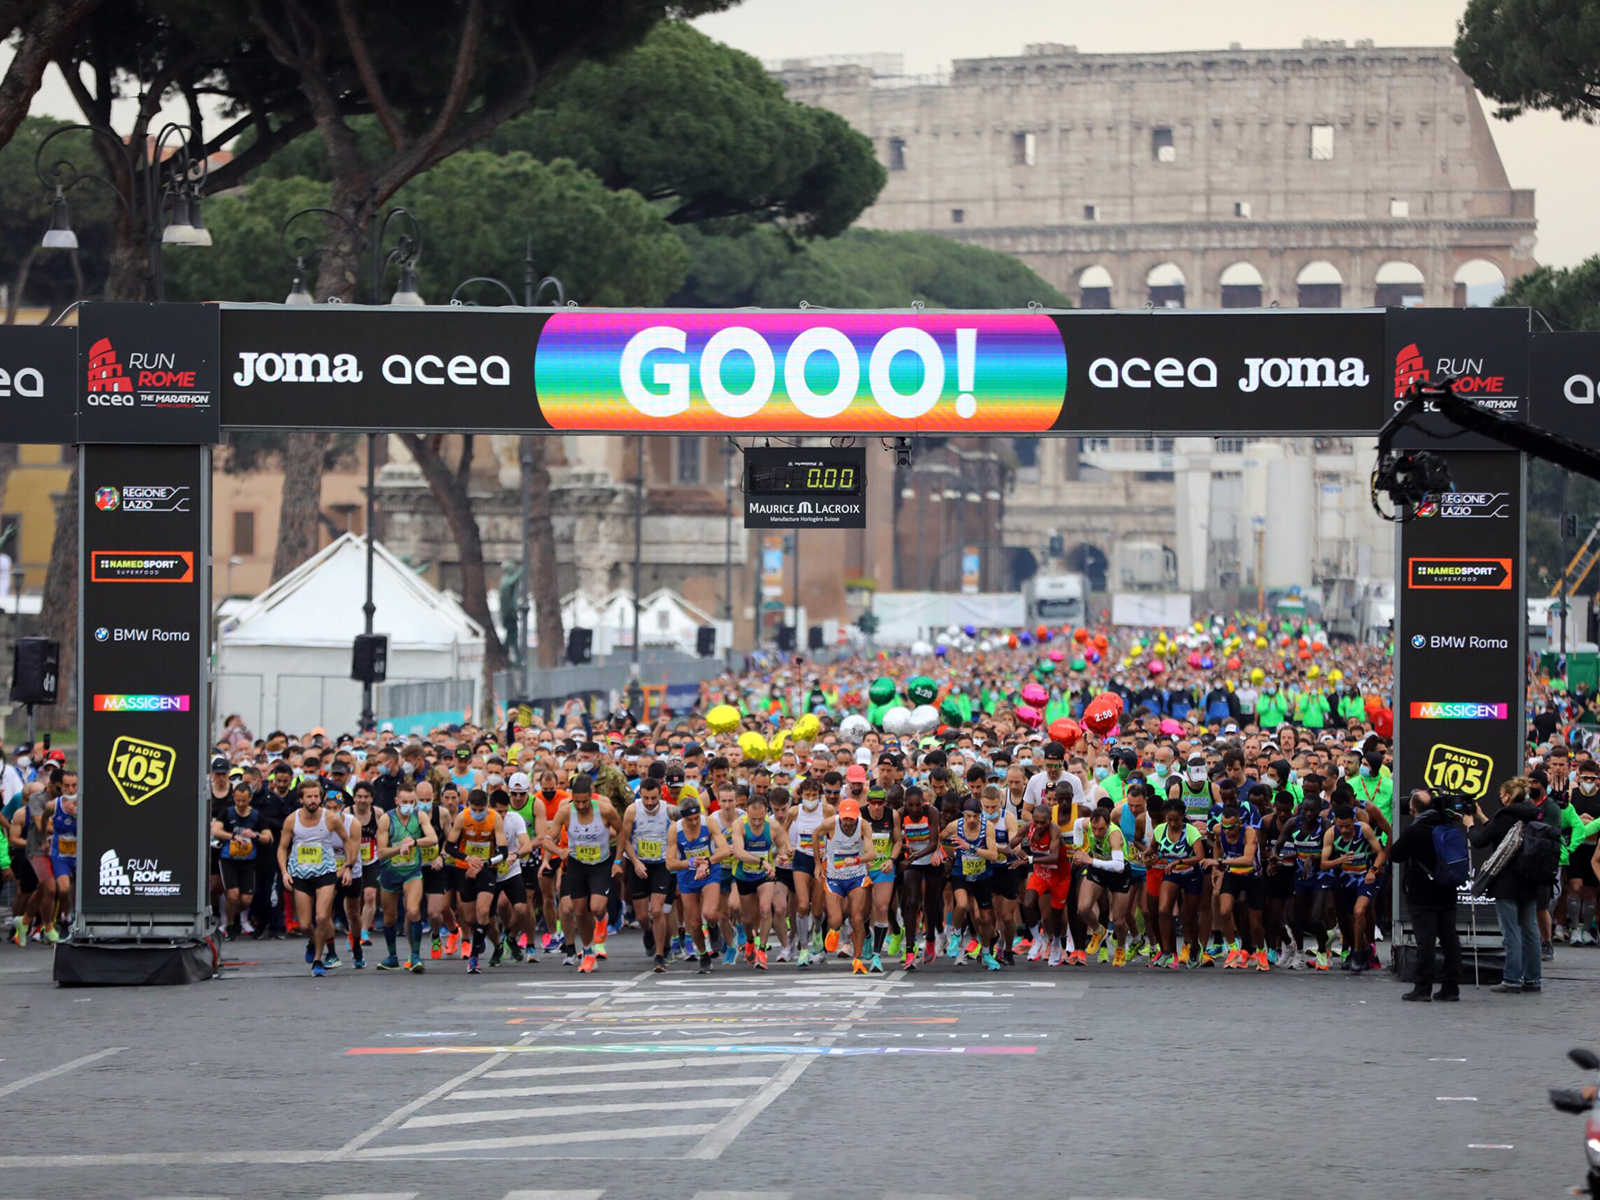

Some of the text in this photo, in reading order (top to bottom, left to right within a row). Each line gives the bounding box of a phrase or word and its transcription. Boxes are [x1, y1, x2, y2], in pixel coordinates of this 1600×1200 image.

[129, 353, 175, 369] RUN
[1436, 358, 1483, 375] RUN
[382, 354, 510, 385] acea
[619, 325, 978, 419] GOOO!
[1088, 357, 1217, 388] acea
[138, 371, 196, 387] ROME
[87, 394, 134, 406] acea
[140, 394, 209, 403] THE MARATHON
[122, 488, 167, 498] REGIONE
[1441, 494, 1486, 503] REGIONE
[122, 500, 153, 509] LAZIO
[749, 502, 794, 514] MAURICE
[815, 502, 860, 514] LACROIX
[1441, 506, 1472, 515] LAZIO
[114, 628, 190, 641] BMW Roma
[1430, 636, 1508, 648] BMW Roma
[915, 686, 933, 699] 3:20
[103, 697, 180, 709] MASSIGEN
[1094, 709, 1113, 723] 2:50
[1420, 704, 1497, 717] MASSIGEN
[127, 744, 161, 759] RADIO
[1444, 752, 1478, 767] RADIO
[116, 753, 166, 787] 105
[1432, 761, 1483, 795] 105
[127, 859, 158, 870] RUN
[132, 870, 172, 882] ROME
[99, 886, 131, 895] acea
